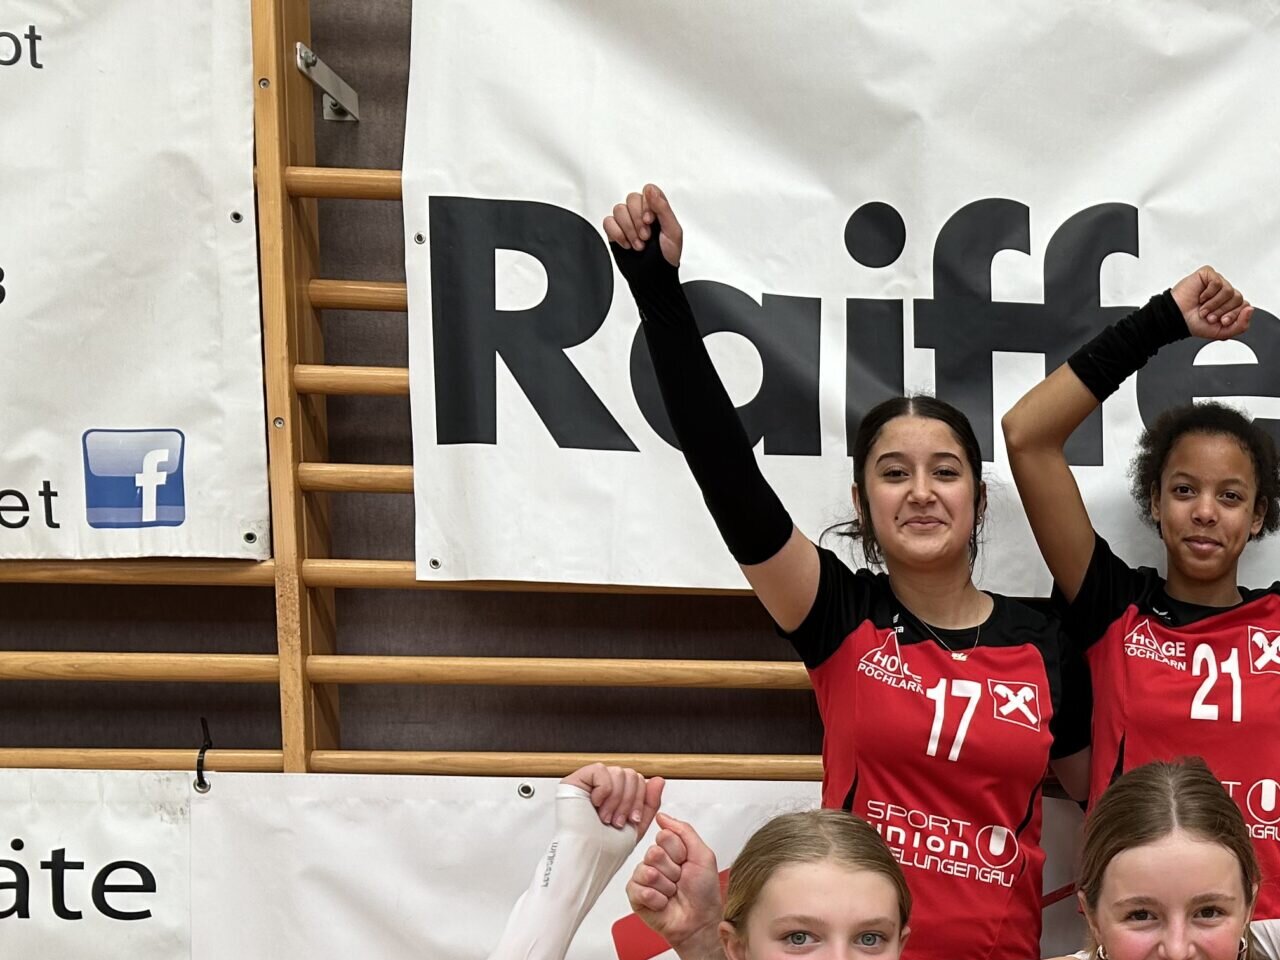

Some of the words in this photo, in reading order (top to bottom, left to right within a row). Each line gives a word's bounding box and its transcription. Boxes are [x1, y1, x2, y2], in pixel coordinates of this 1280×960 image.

[926, 677, 982, 762] 17
[1190, 642, 1242, 722] 21
[867, 799, 972, 838] SPORT
